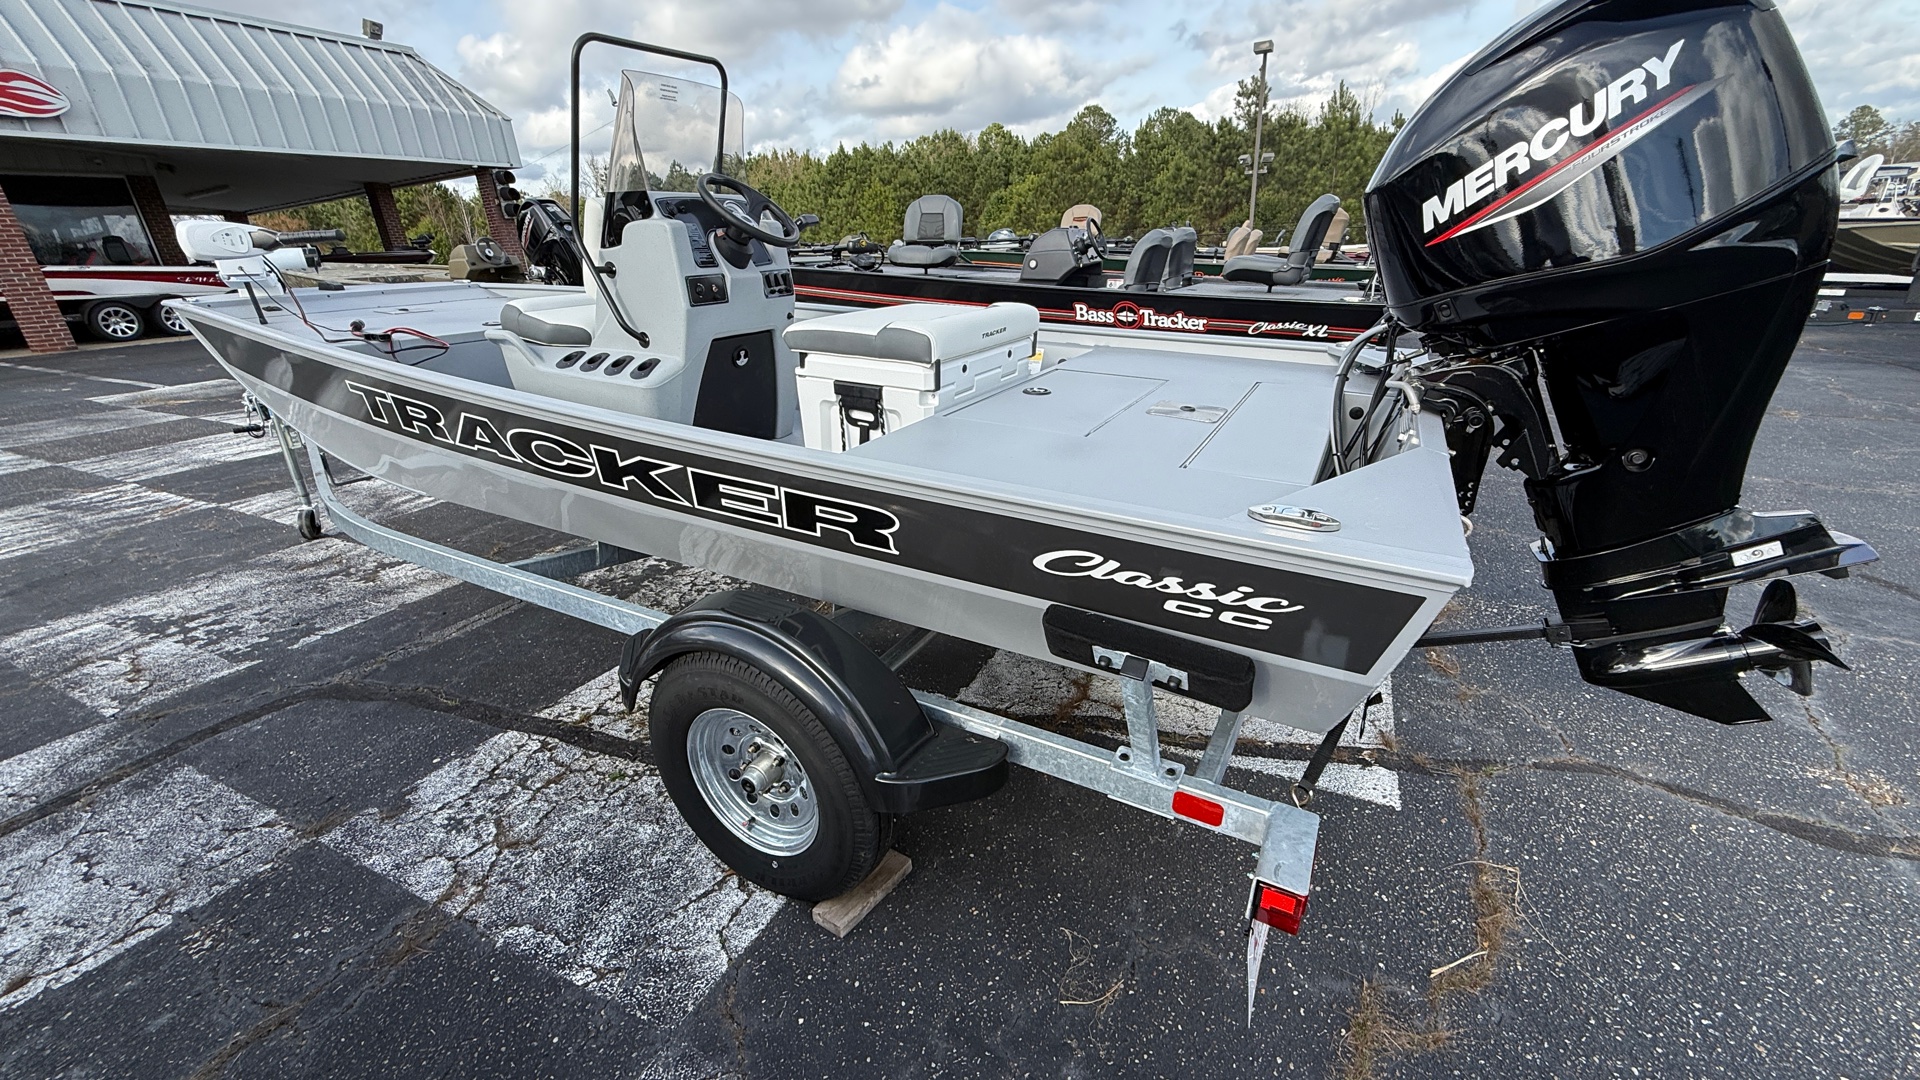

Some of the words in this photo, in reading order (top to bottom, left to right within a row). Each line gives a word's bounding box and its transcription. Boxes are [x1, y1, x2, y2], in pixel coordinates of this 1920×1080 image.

[1422, 38, 1685, 234] MERCURY
[1571, 107, 1670, 170] FOURSTROKE
[982, 326, 1007, 339] TRACKER
[1074, 303, 1115, 324] Bass
[1139, 309, 1208, 331] Tracker
[1247, 320, 1308, 335] Classic
[1302, 324, 1329, 338] XL
[344, 379, 901, 556] TRACKER
[1032, 549, 1305, 613] Classic
[1163, 599, 1273, 630] CC
